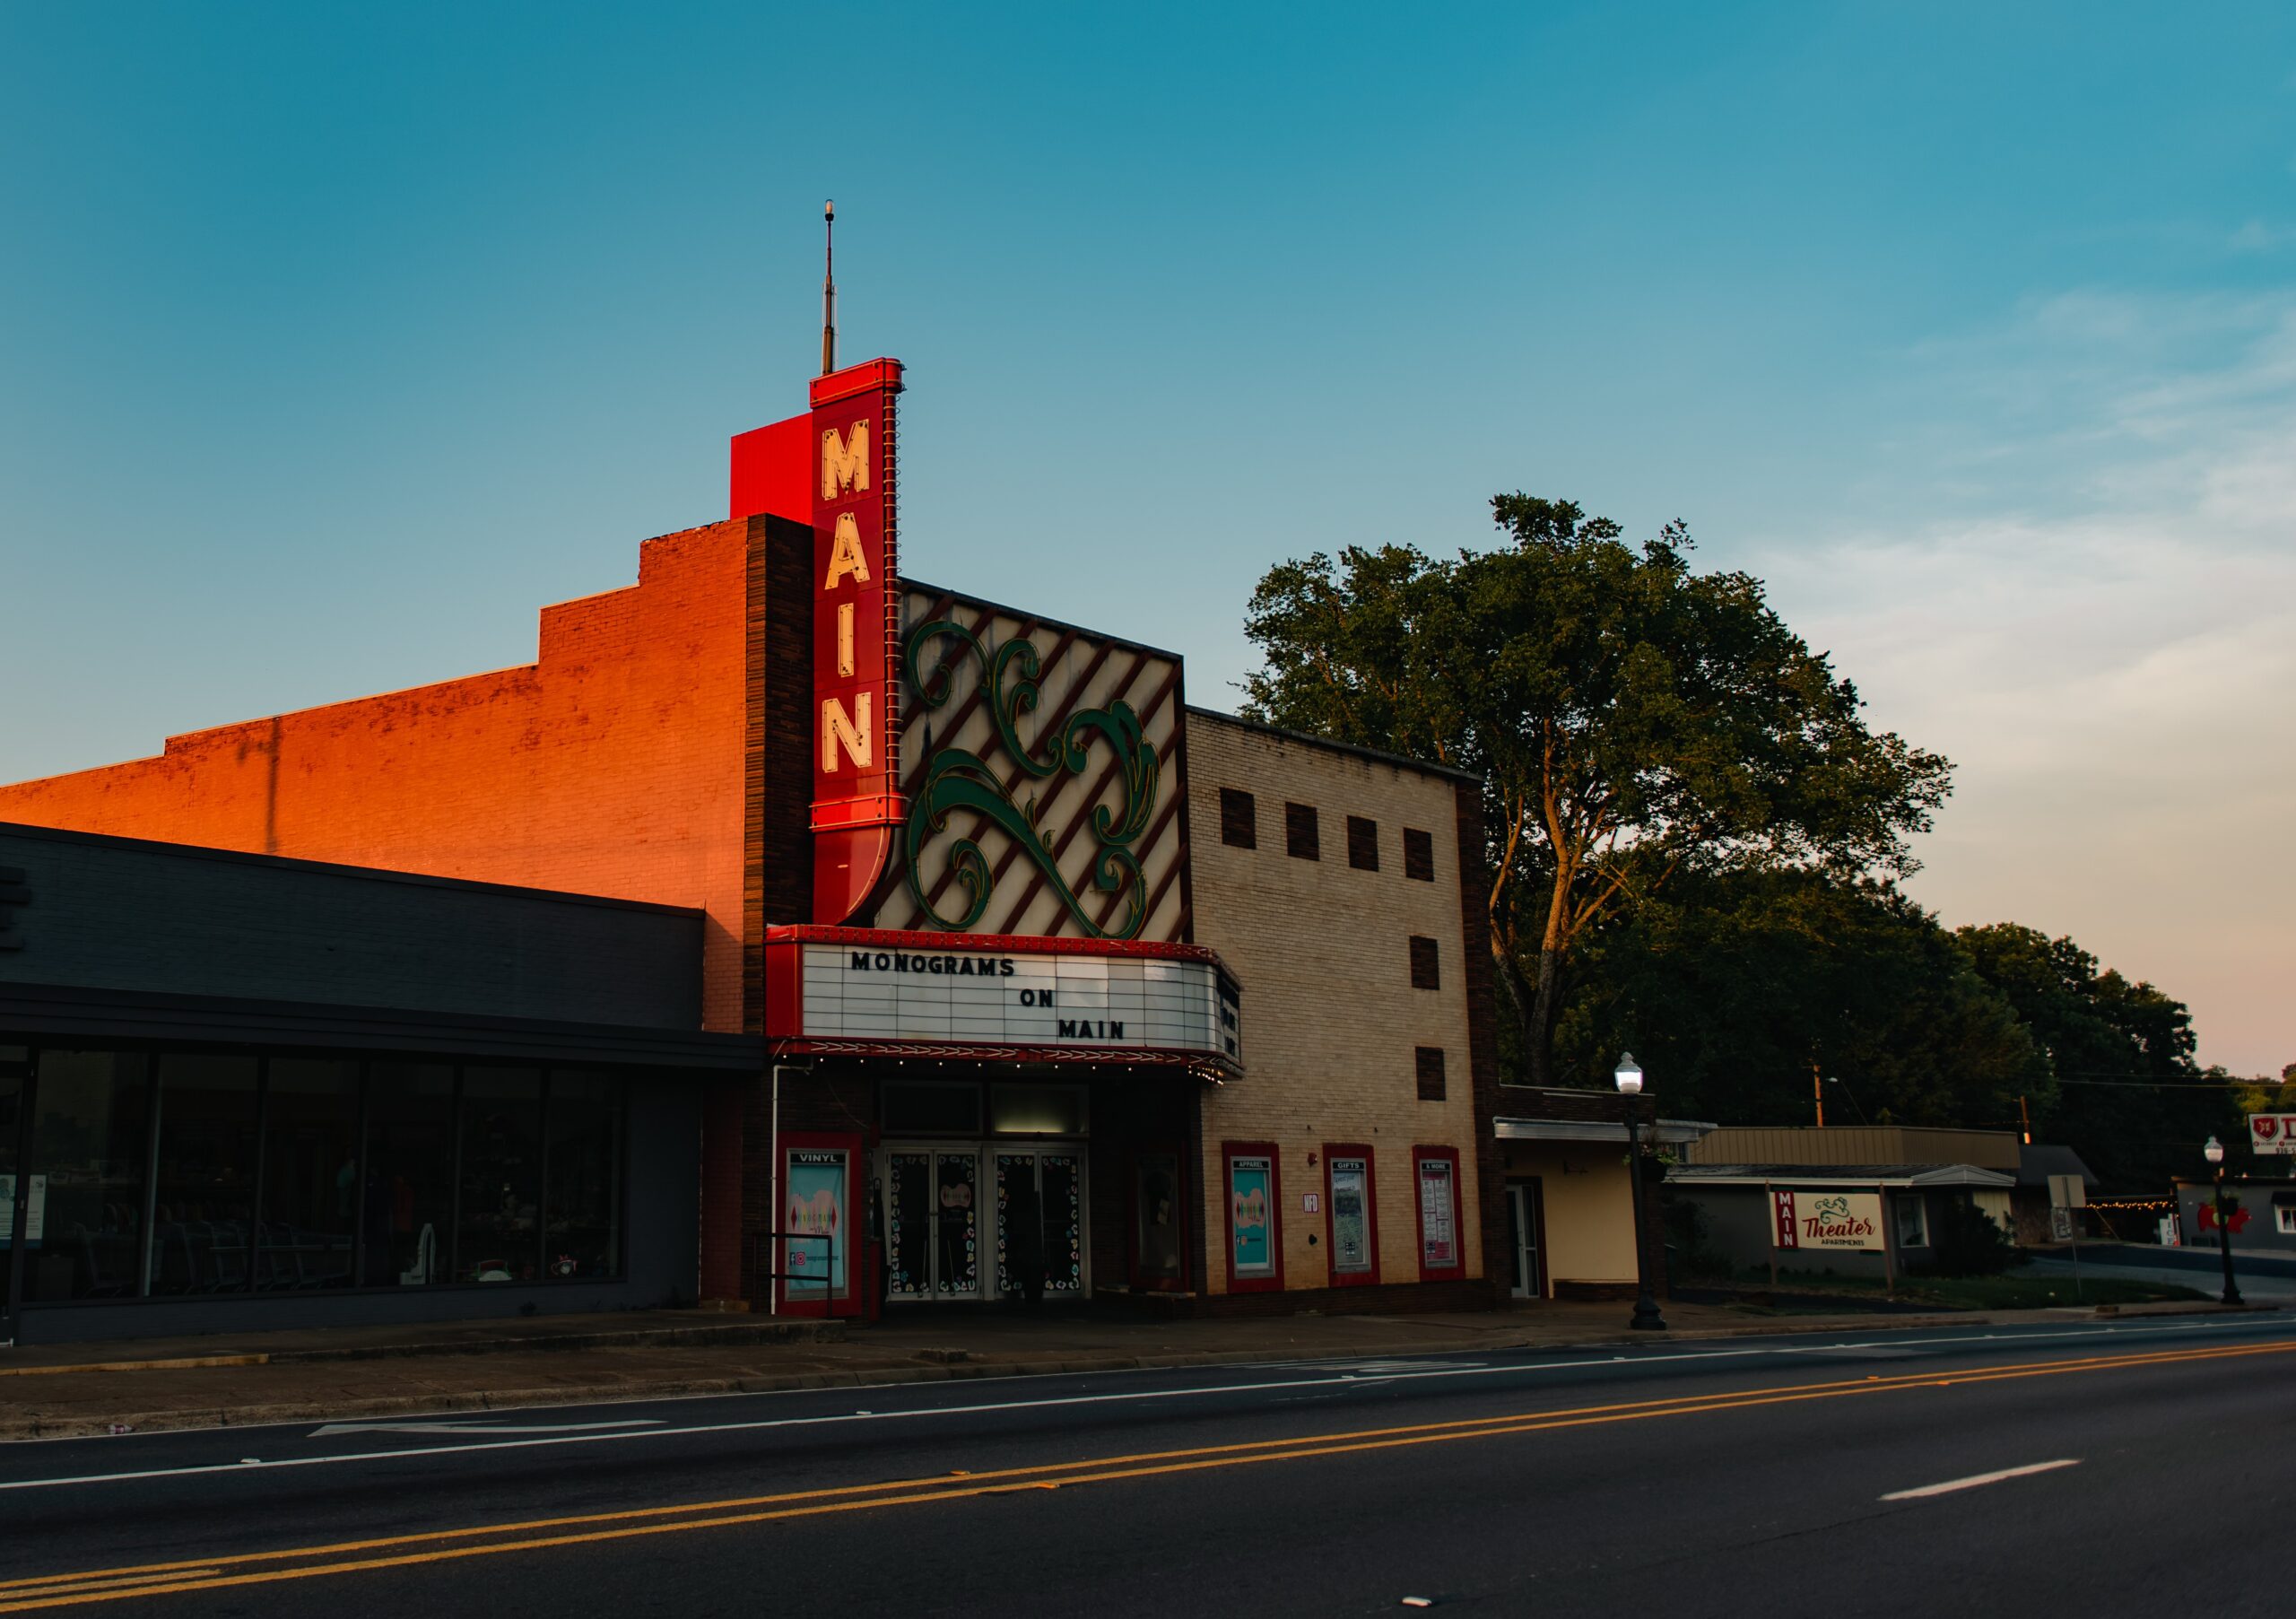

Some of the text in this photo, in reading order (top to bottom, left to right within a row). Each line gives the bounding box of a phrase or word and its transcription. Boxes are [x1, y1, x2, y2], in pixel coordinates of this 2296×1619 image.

[822, 418, 873, 773] MAIN
[851, 952, 1014, 977] MONOGRAMS
[1020, 988, 1053, 1007] ON
[1058, 1019, 1124, 1040] MAIN
[800, 1154, 837, 1162] VINYL
[1779, 1193, 1793, 1246] MAIN
[1802, 1217, 1875, 1238] Theater
